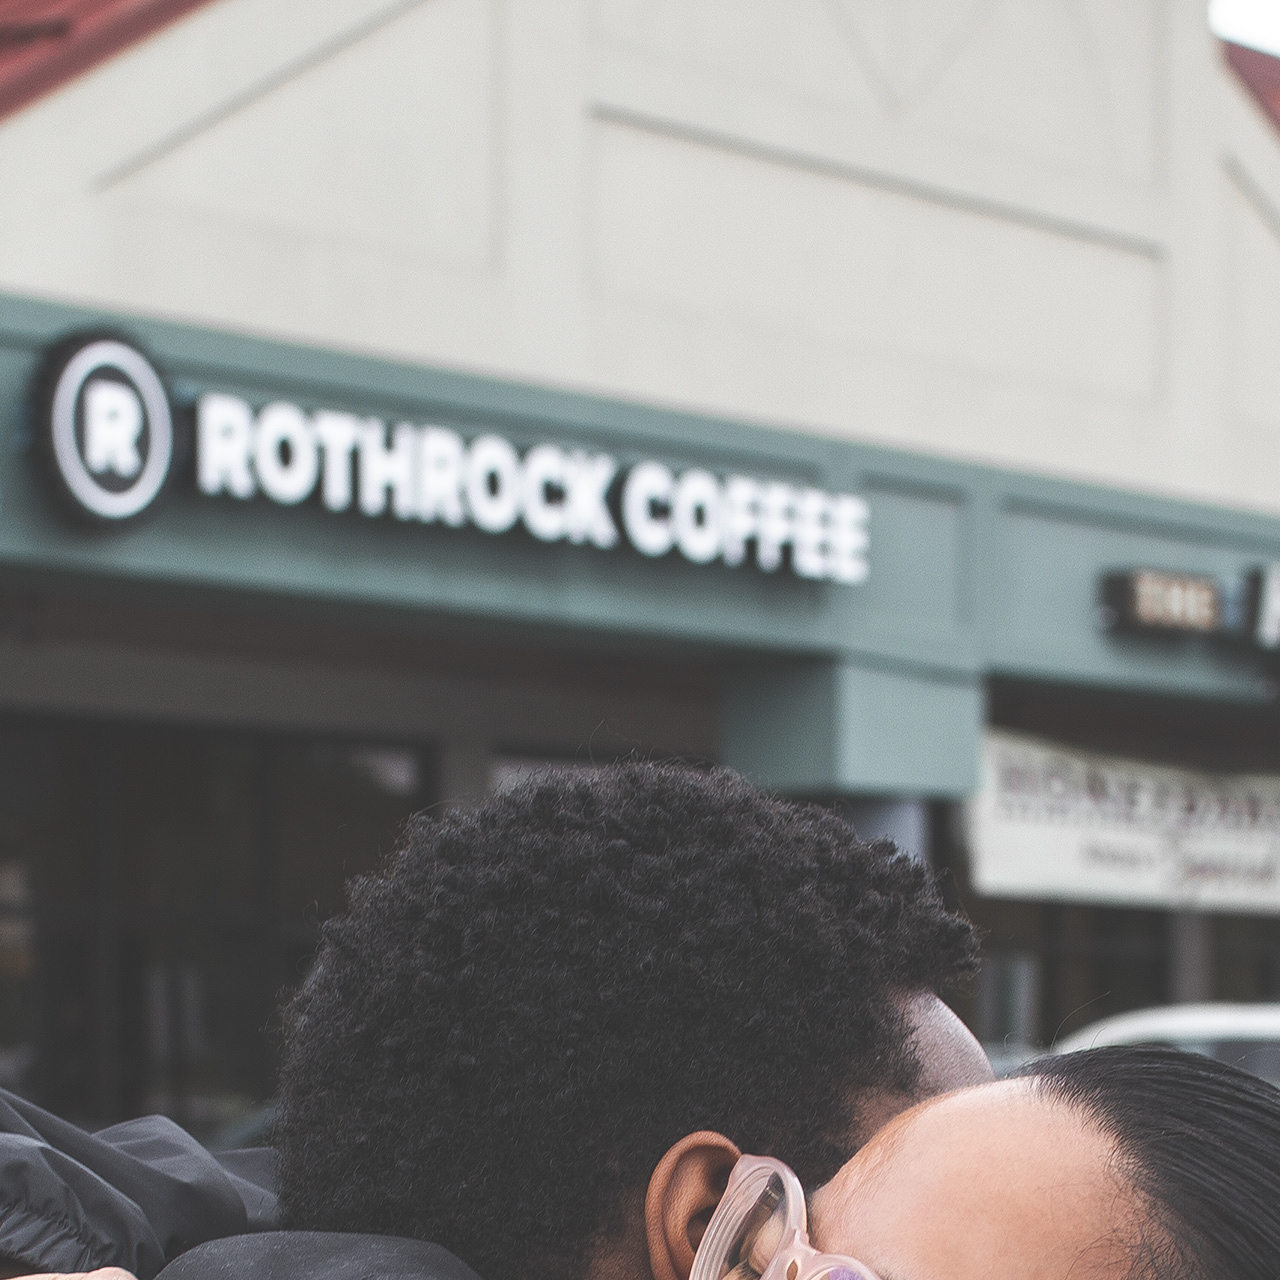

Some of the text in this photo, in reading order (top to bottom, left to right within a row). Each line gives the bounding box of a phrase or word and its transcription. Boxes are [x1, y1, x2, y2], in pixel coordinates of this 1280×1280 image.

[84, 379, 144, 477] R
[197, 394, 869, 585] ROTHROCK COFFEE
[1133, 566, 1218, 630] THE
